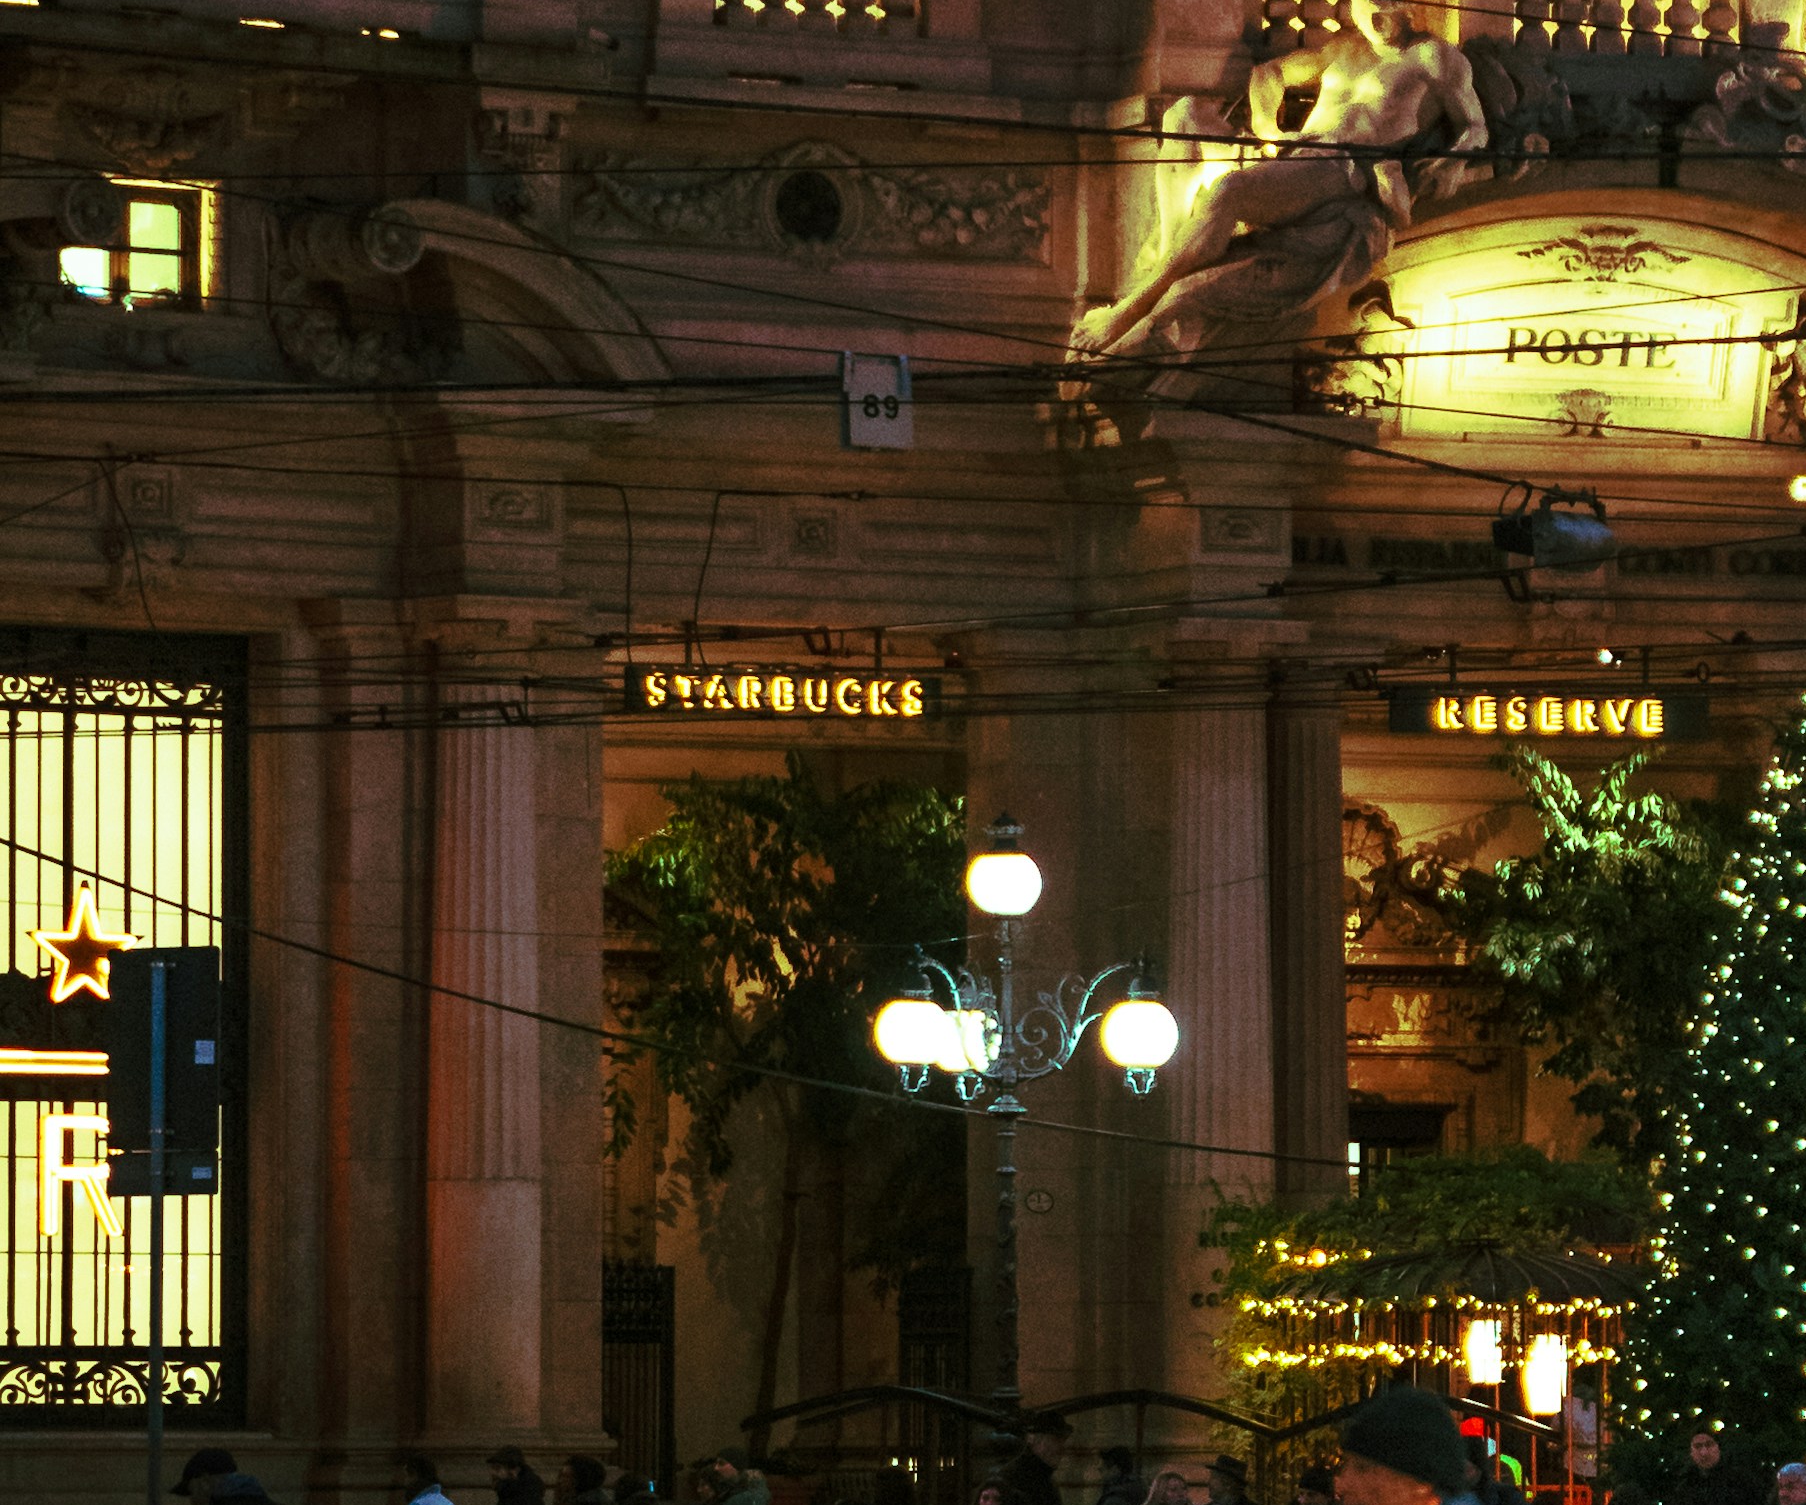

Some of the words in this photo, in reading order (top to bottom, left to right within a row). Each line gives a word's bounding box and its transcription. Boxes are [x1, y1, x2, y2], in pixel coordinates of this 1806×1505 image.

[1505, 327, 1678, 369] POSTE
[863, 394, 899, 420] 89
[645, 671, 924, 717] STARBUCKS
[1434, 695, 1665, 735] RESERVE
